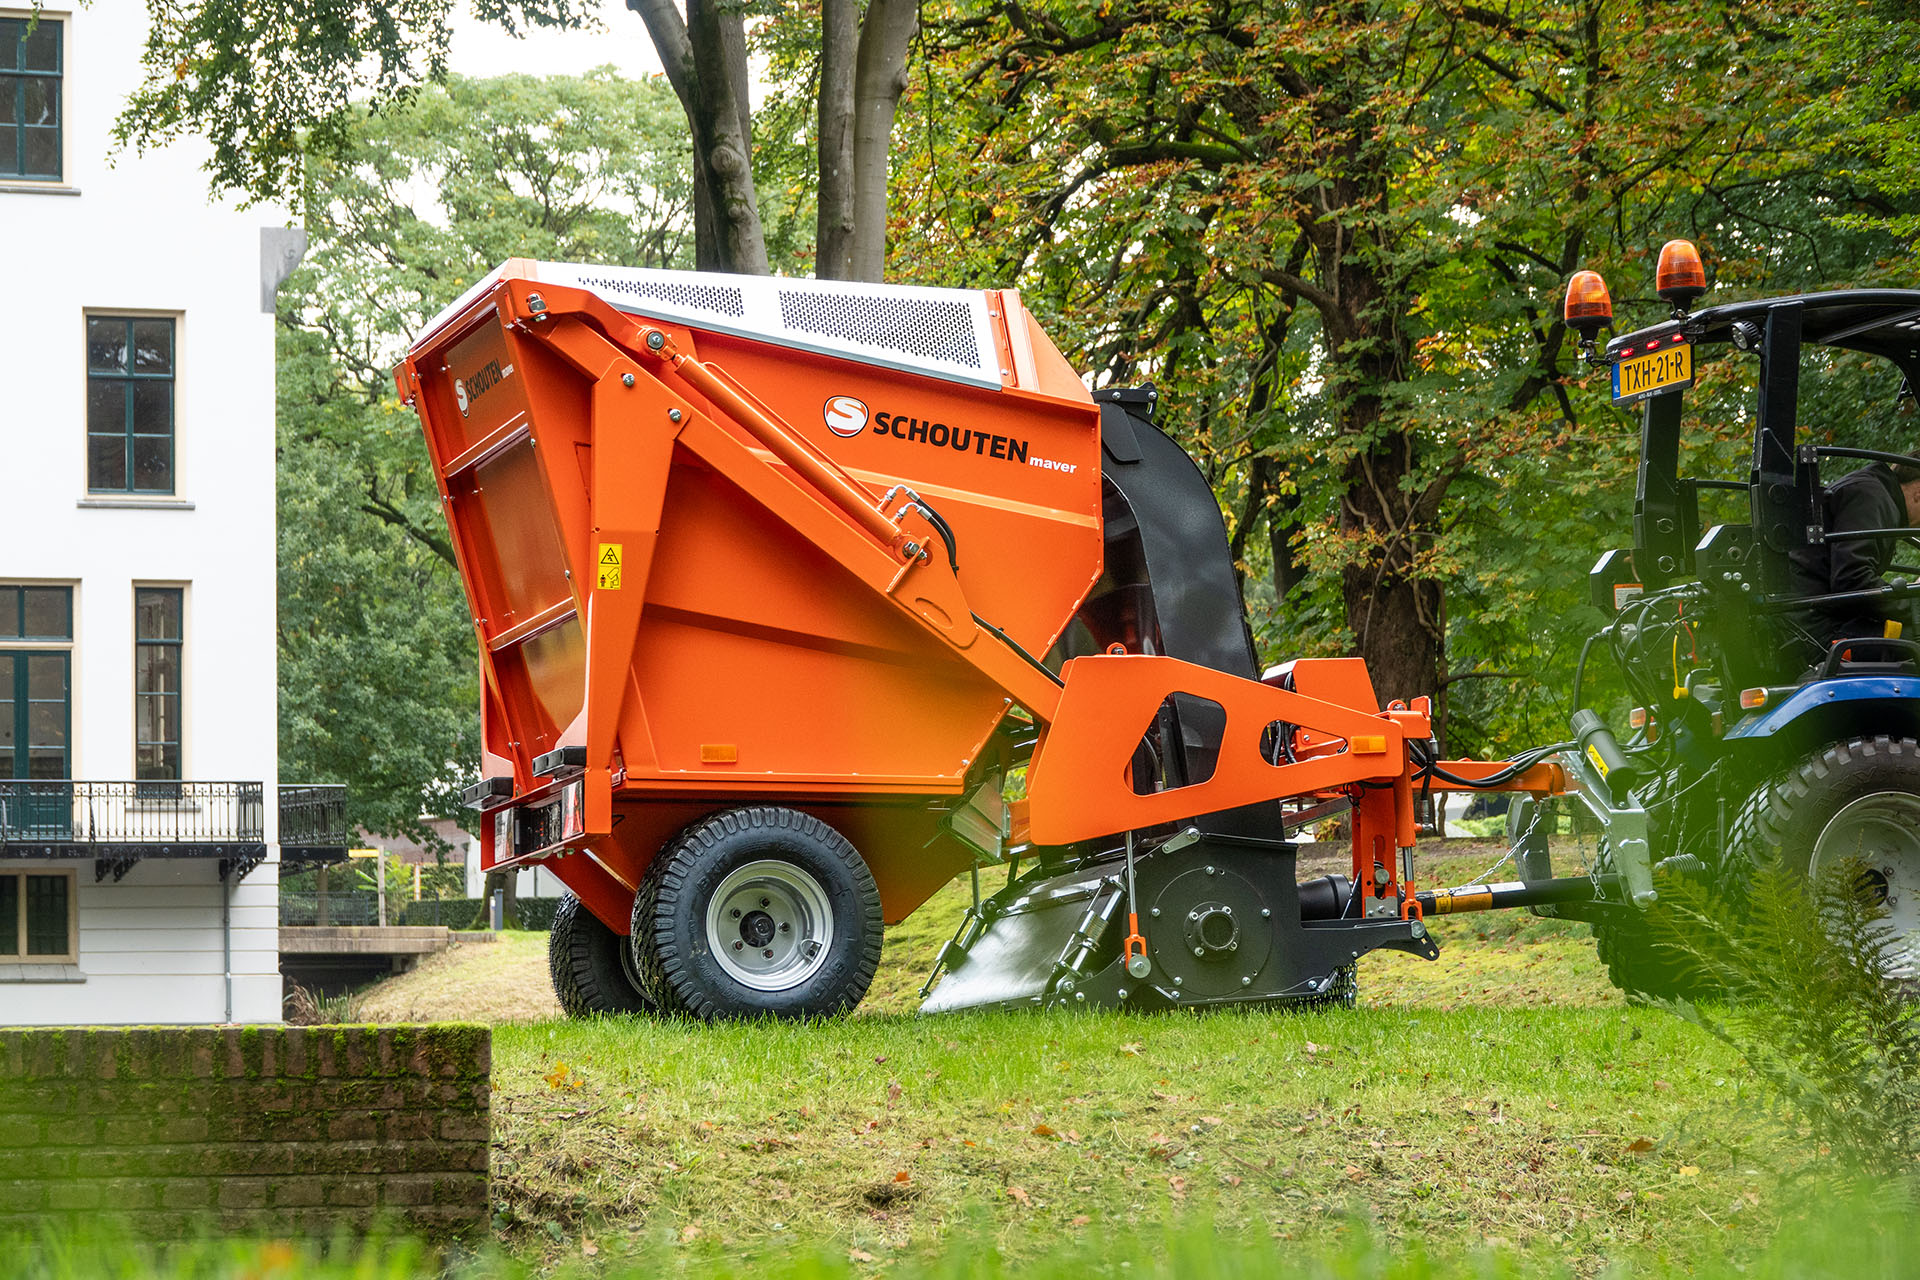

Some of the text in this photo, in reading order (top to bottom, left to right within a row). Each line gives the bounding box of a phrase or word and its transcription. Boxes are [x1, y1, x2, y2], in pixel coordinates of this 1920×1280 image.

[465, 358, 503, 403] SCHOUTEN
[1624, 351, 1684, 391] TXH-21-R
[873, 412, 1029, 464] SCHOUTEN
[1029, 456, 1077, 474] maver
